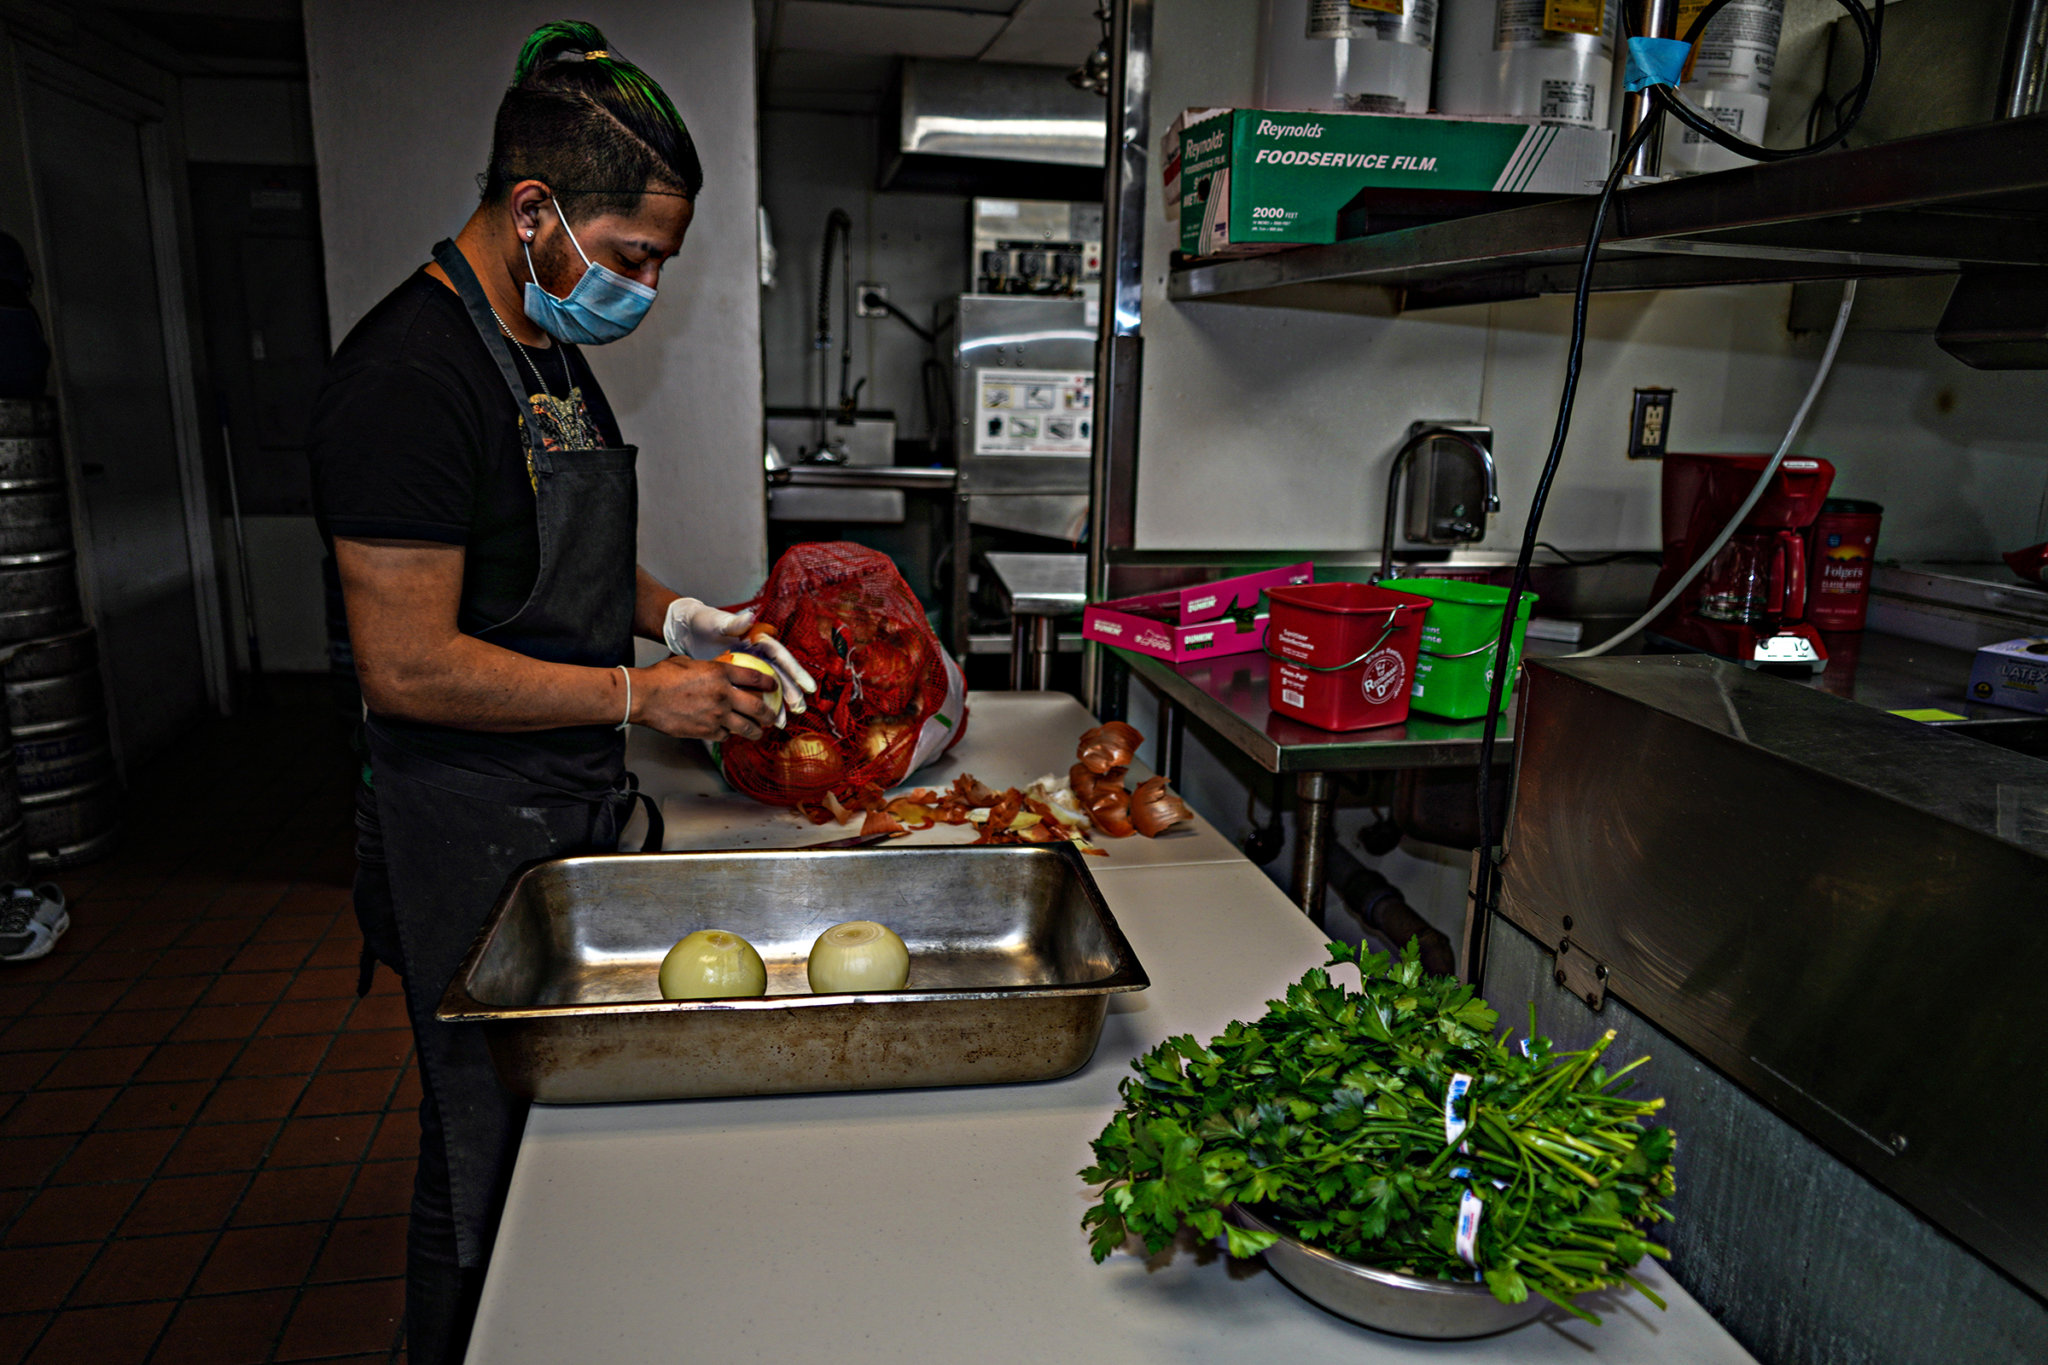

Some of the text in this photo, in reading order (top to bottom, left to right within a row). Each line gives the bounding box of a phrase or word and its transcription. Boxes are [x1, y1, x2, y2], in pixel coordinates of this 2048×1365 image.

[1256, 119, 1324, 140] Reynolds
[1184, 129, 1225, 162] Reynolds
[1255, 149, 1390, 169] FOODSERVICE
[1252, 206, 1284, 219] 2000
[1824, 564, 1864, 580] Folgers
[2001, 665, 2048, 681] LATEX
